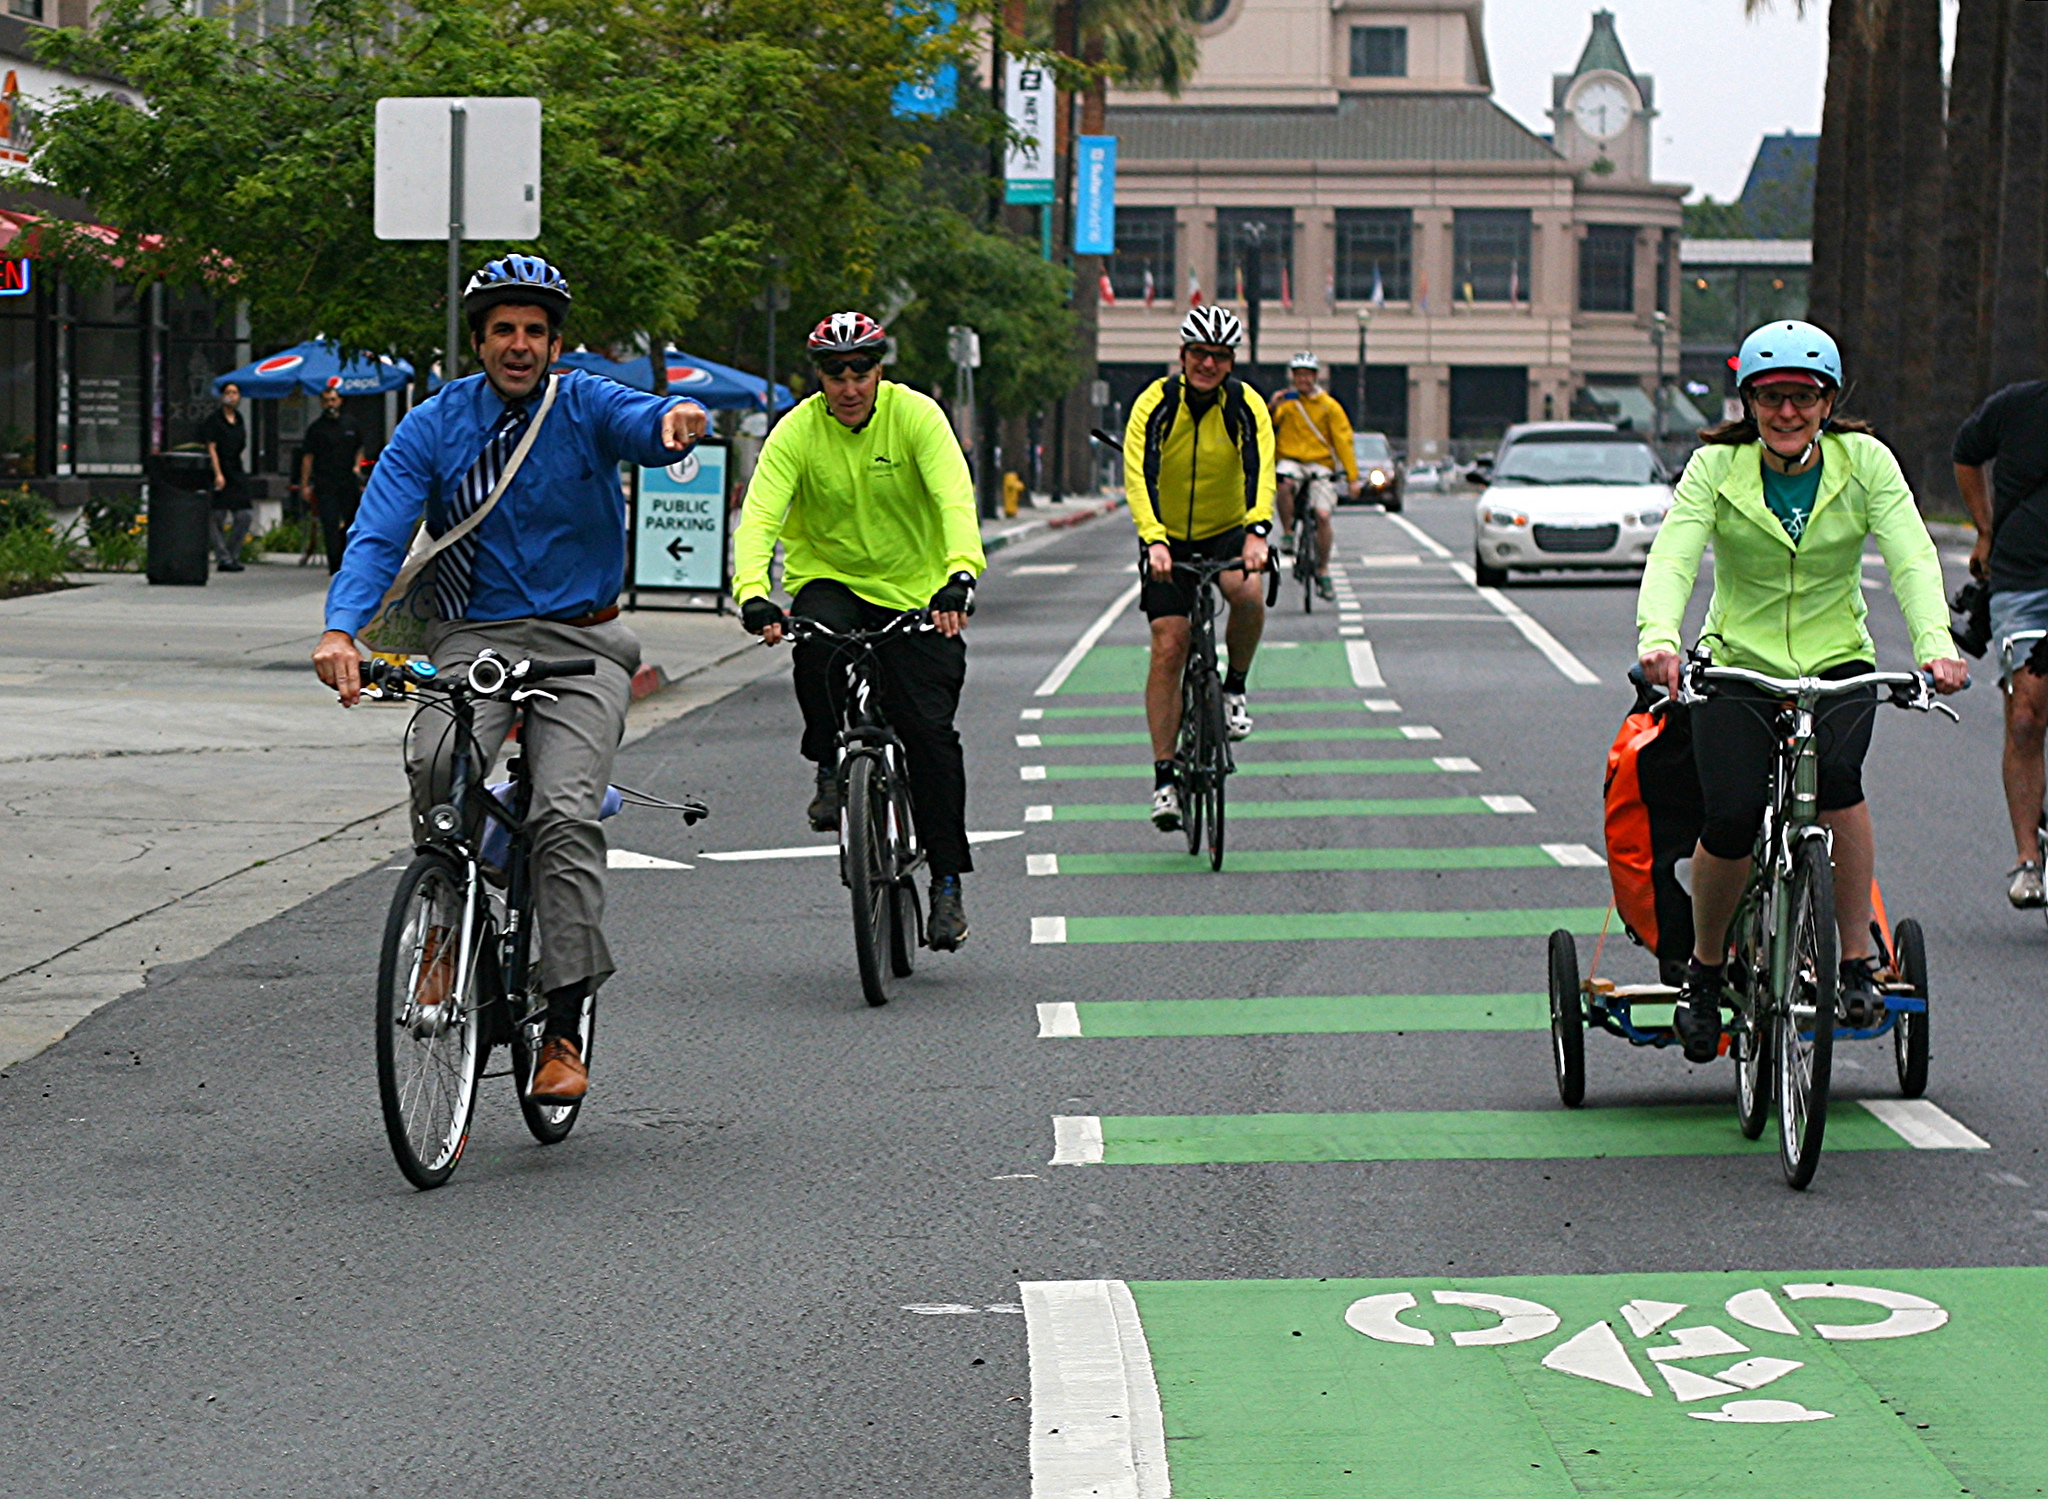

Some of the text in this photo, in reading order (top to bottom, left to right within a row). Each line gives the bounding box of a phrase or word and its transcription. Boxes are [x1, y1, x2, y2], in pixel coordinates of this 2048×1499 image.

[0, 260, 23, 289] N
[345, 375, 380, 390] pepsi
[652, 499, 710, 514] PUBLIC
[645, 516, 716, 532] PARKING
